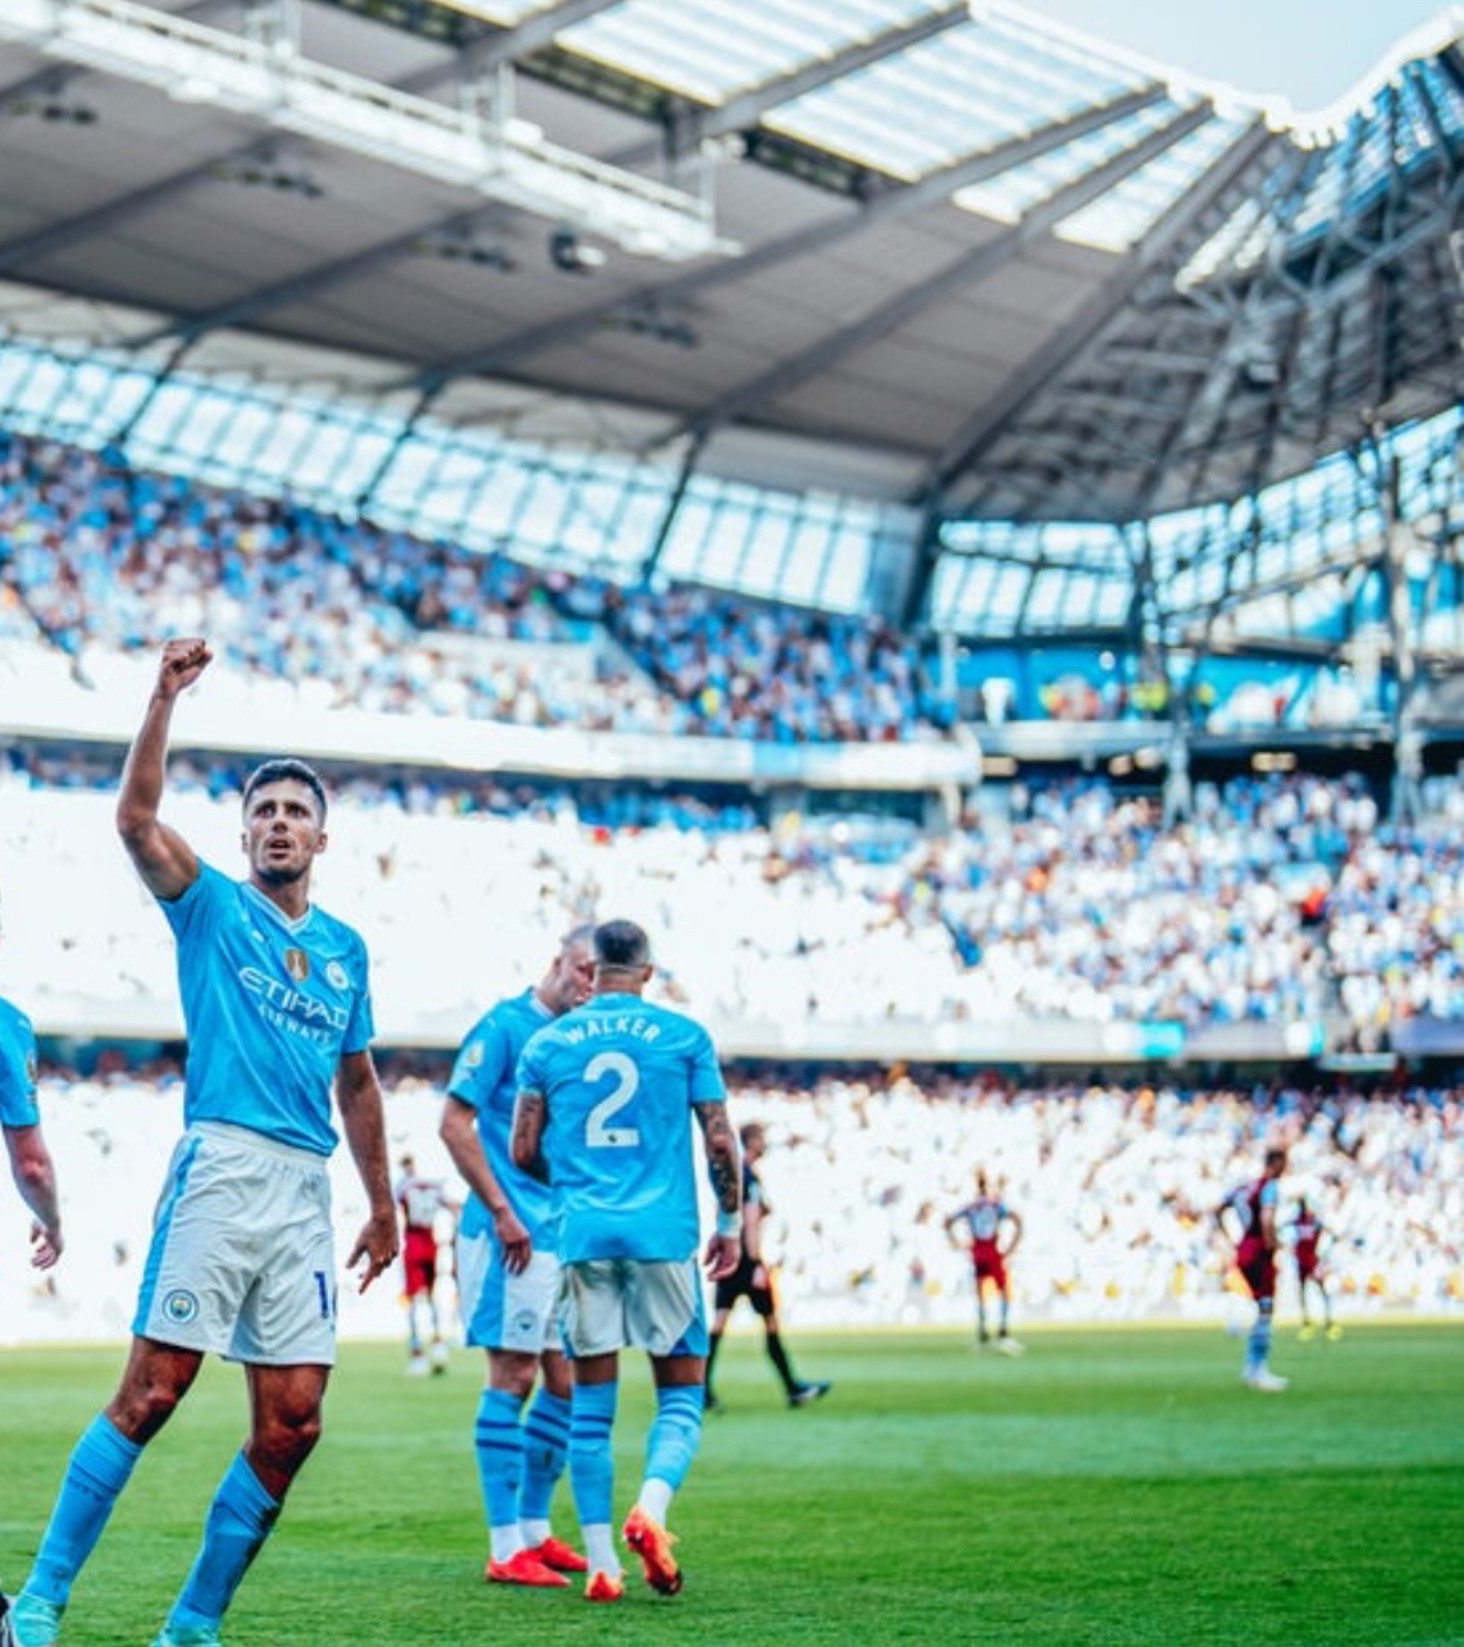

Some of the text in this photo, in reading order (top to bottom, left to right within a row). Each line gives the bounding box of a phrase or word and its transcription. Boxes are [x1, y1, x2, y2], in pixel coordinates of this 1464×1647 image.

[239, 966, 349, 1030] ETIHAD
[566, 1016, 661, 1044] WALKER
[582, 1051, 640, 1147] 2
[313, 1270, 337, 1319] 1
